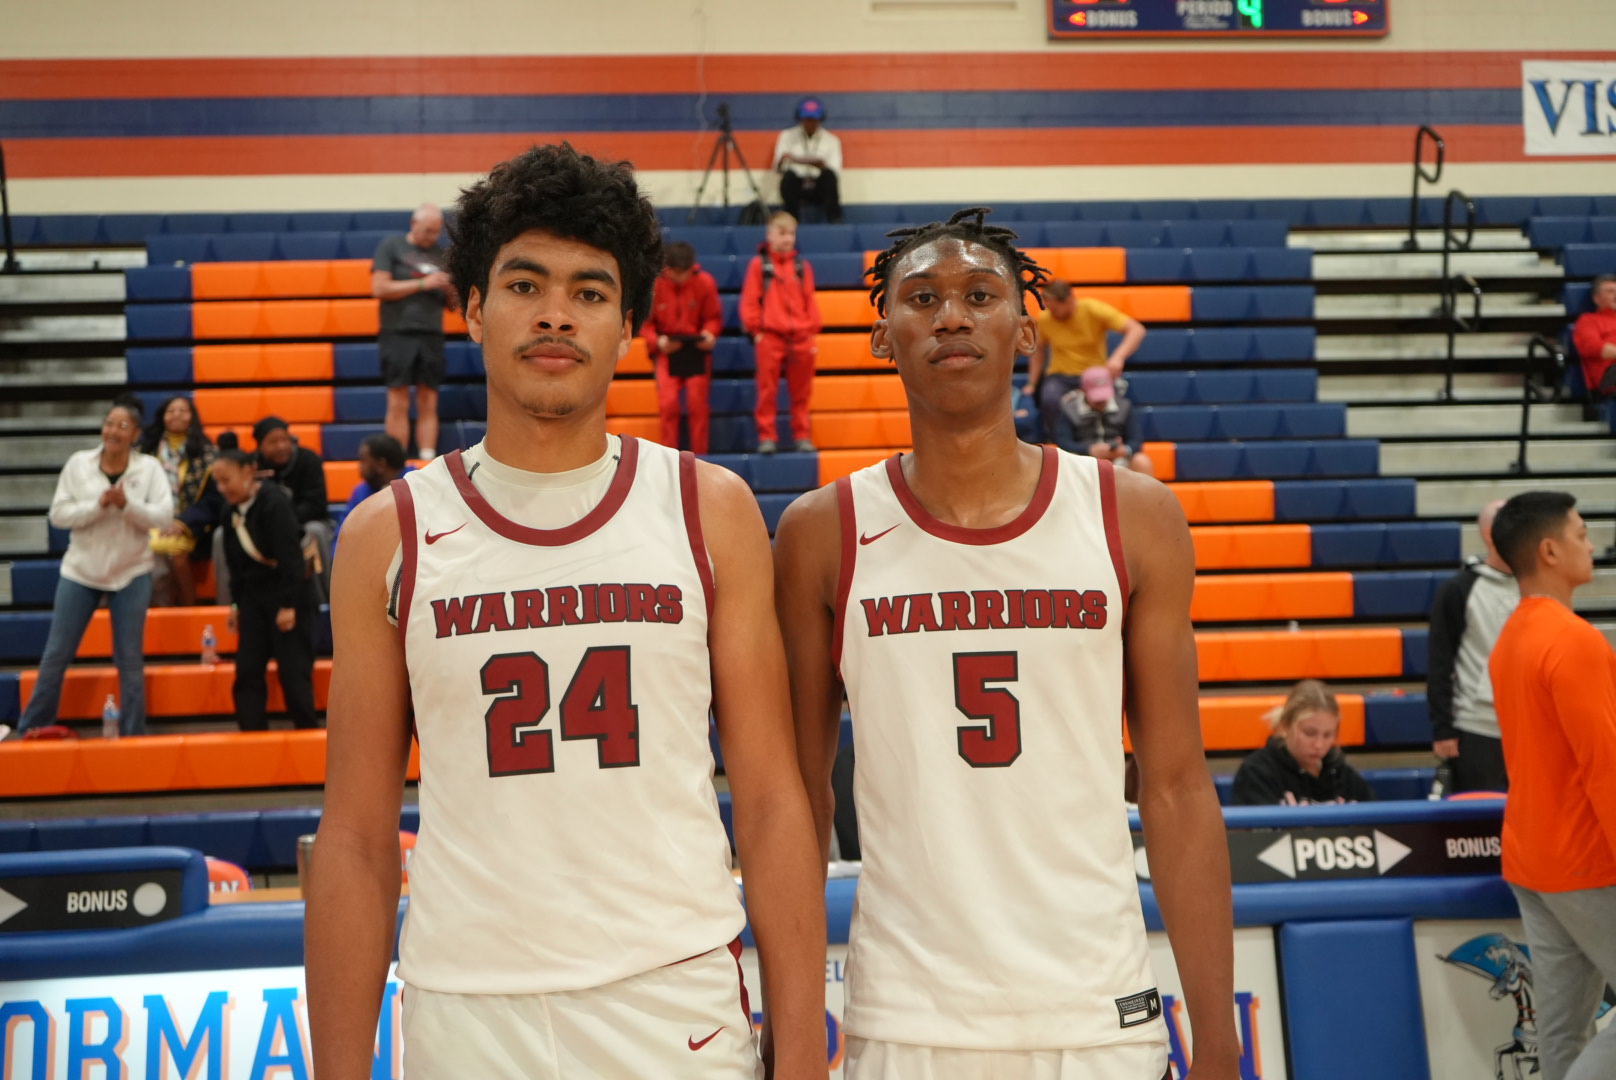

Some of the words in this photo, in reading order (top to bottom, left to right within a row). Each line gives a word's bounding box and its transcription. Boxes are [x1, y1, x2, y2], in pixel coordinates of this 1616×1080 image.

[1085, 9, 1138, 28] BONUS
[1301, 8, 1353, 27] BONUS
[430, 583, 683, 639] WARRIORS
[860, 589, 1107, 637] WARRIORS
[479, 644, 640, 777] 24
[952, 650, 1022, 768] 5
[1294, 835, 1375, 871] POSS
[1446, 836, 1502, 858] BONUS
[66, 889, 128, 913] BONUS
